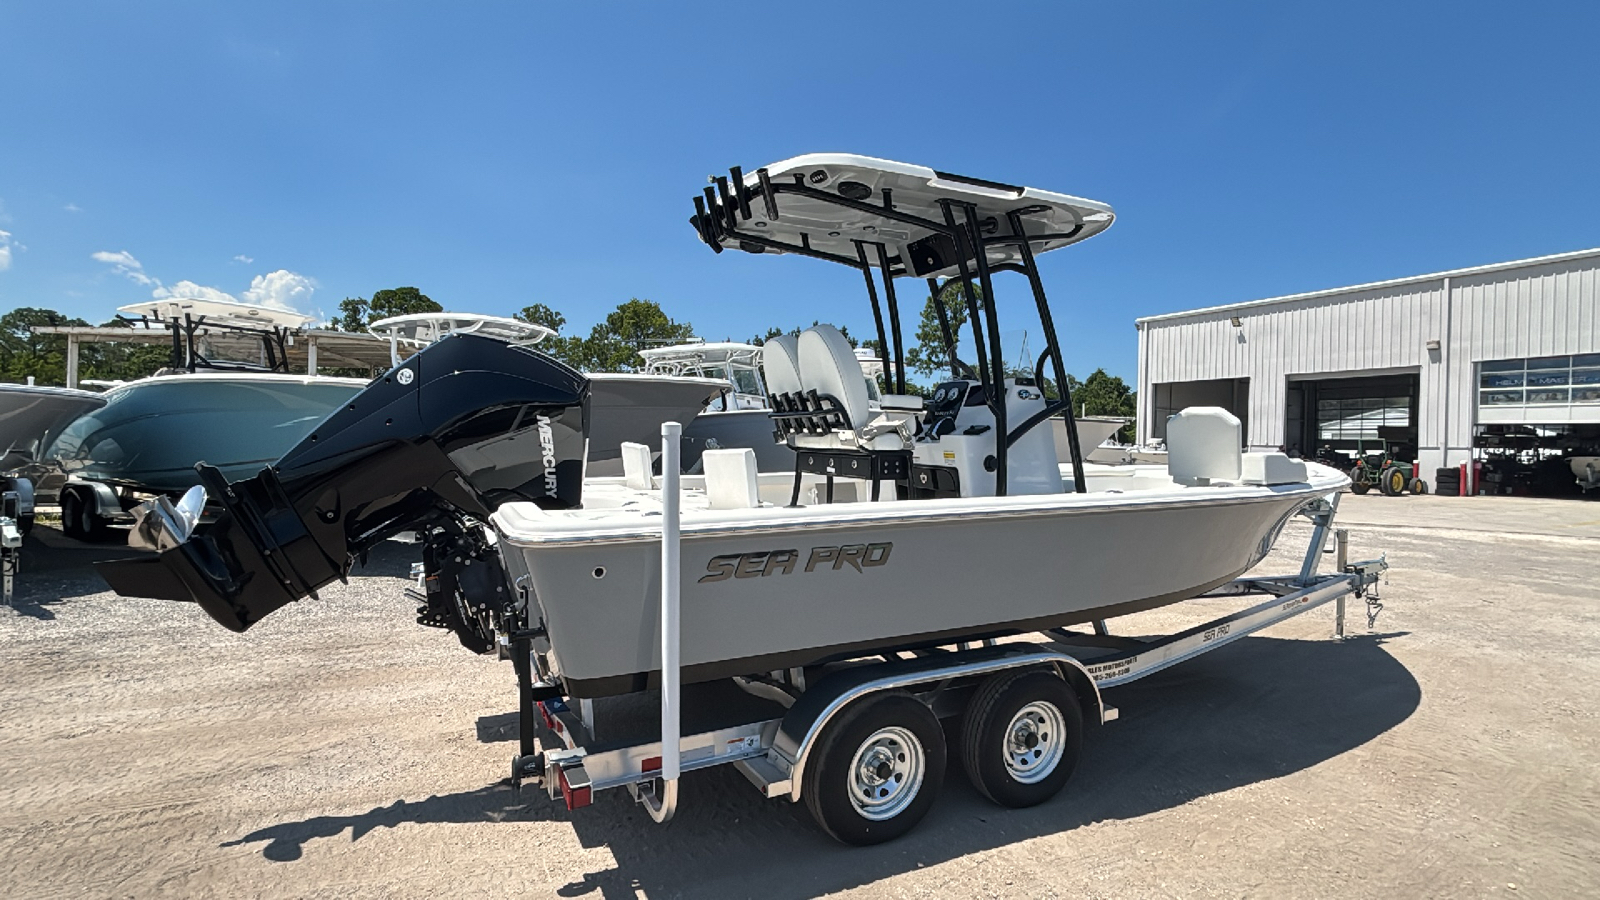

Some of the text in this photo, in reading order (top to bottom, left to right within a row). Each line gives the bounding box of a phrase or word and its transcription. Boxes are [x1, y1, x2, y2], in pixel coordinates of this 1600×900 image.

[536, 414, 558, 499] MERCURY
[698, 541, 894, 583] SEA PRO
[1203, 624, 1231, 642] SEA PRO
[1102, 656, 1138, 671] MOTORSPORTS
